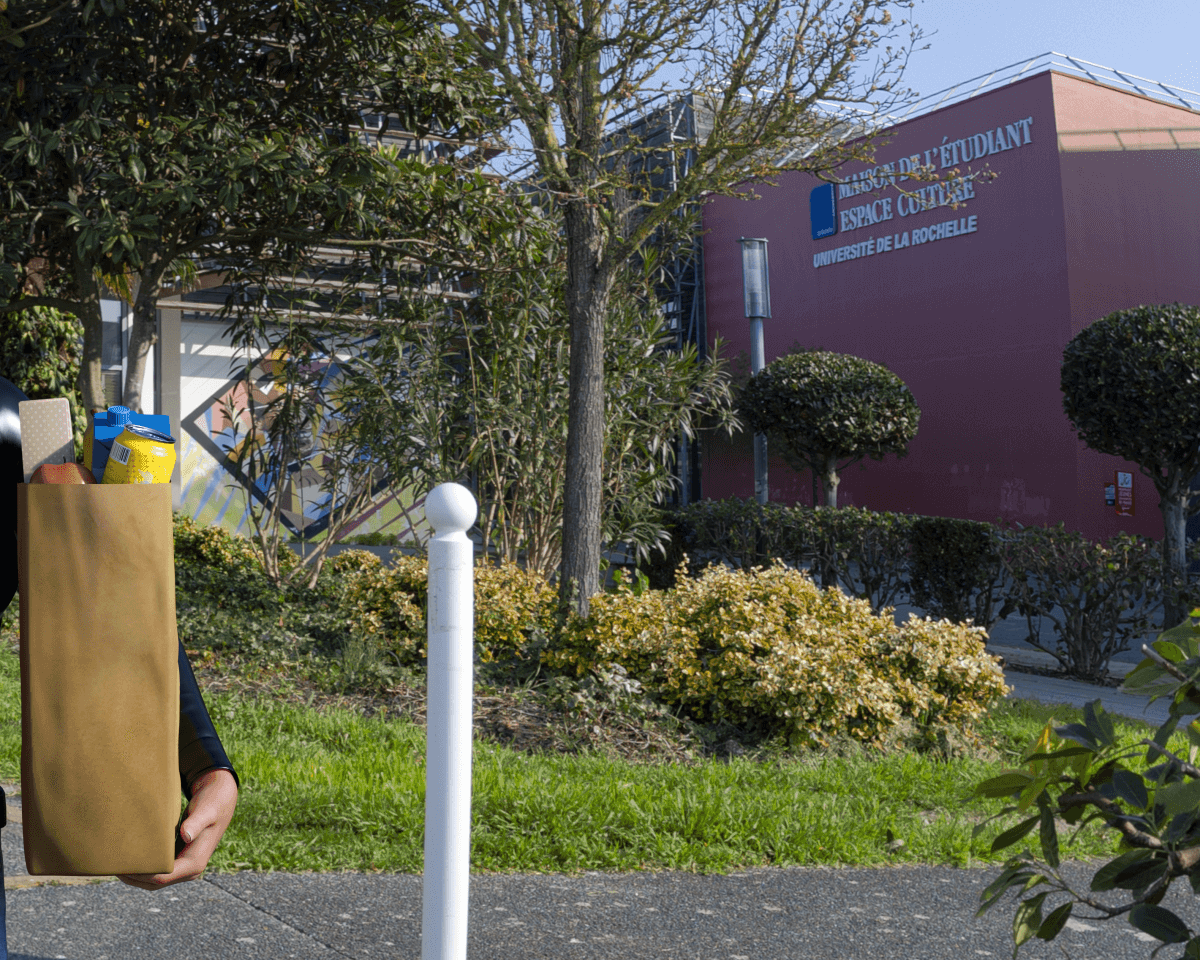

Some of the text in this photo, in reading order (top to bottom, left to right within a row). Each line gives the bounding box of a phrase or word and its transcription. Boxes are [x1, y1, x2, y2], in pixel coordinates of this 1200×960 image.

[838, 162, 896, 200] MAISON
[898, 153, 921, 181] DE
[839, 198, 894, 233] ESPACE
[813, 214, 978, 269] UNIVERSITÉ DE LA ROCHELLE
